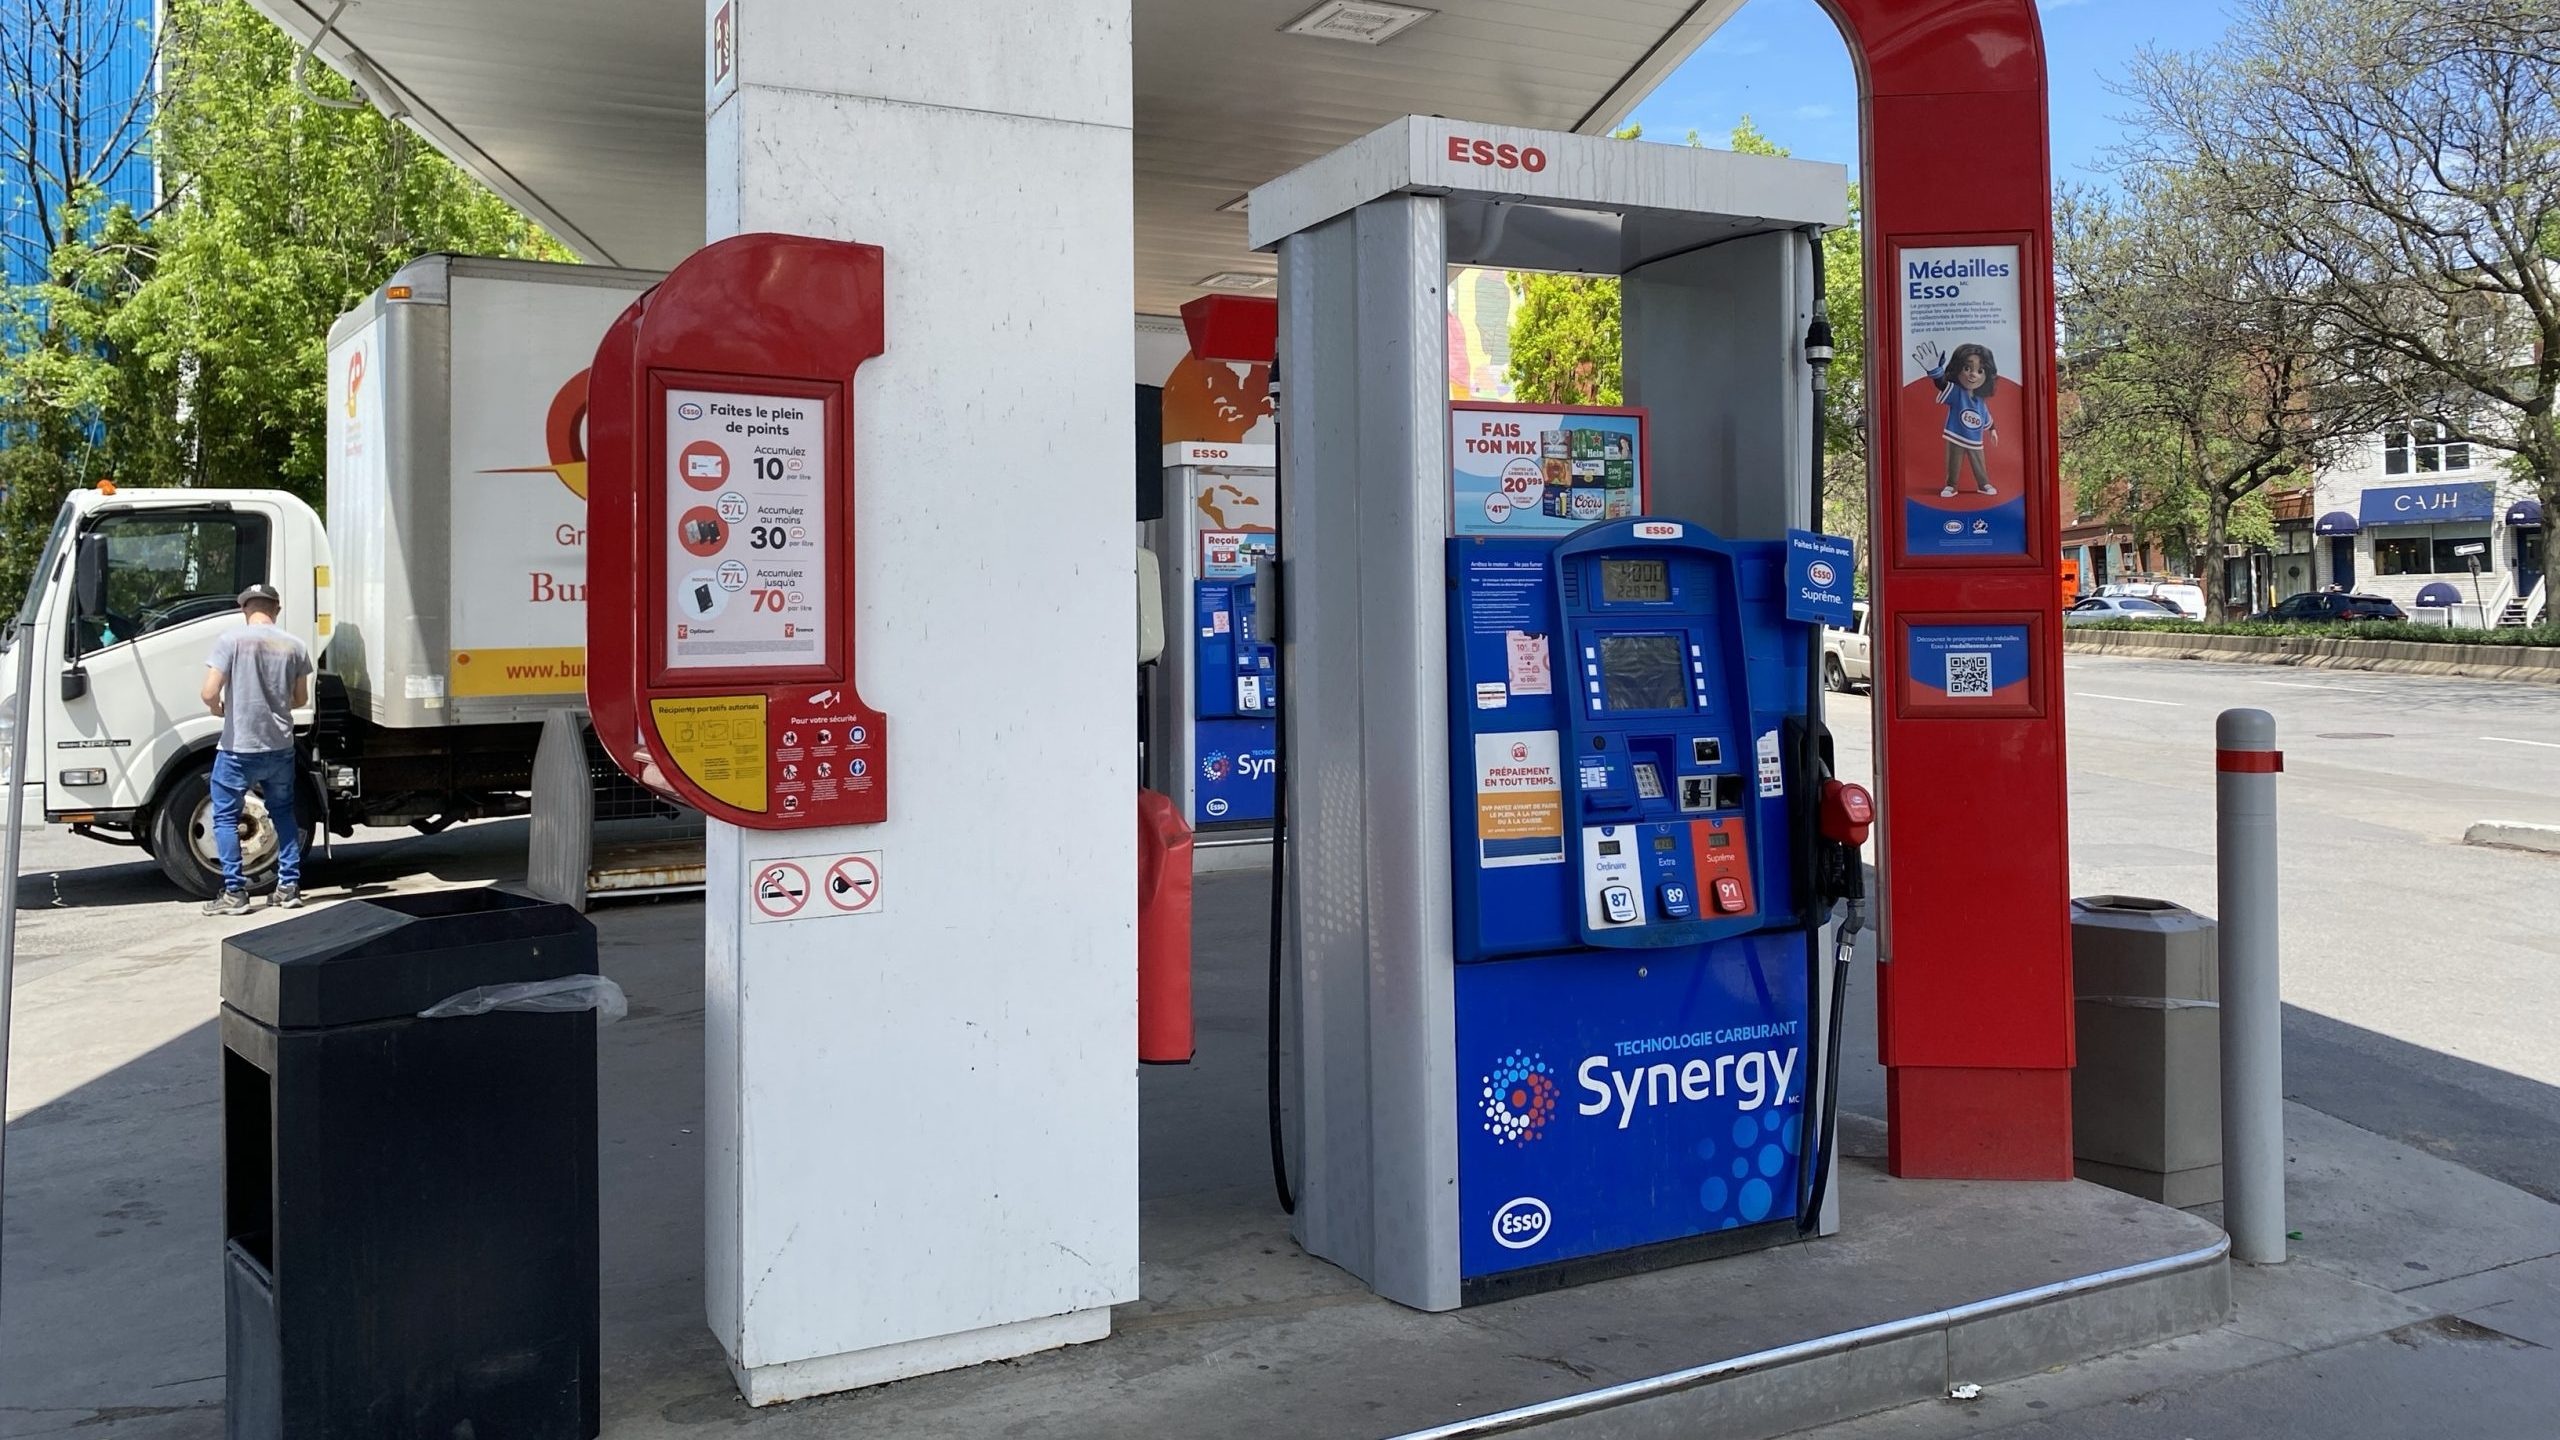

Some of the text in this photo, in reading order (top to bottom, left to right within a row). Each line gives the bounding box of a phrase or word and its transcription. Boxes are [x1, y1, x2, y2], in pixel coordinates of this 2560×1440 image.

[1448, 136, 1546, 173] ESSO
[1909, 258, 2009, 280] Médailles
[1909, 281, 1960, 300] Esso
[682, 403, 804, 422] Esso Faites le plein
[1963, 412, 1980, 425] Esso
[726, 421, 790, 437] de points
[1481, 422, 1521, 437] FAIS
[754, 446, 806, 456] Accumulez
[1192, 449, 1228, 458] ESSO
[1465, 439, 1502, 454] TON
[1506, 440, 1537, 455] MIX
[753, 457, 784, 480] 10
[1574, 494, 1602, 508] Coors
[2394, 492, 2458, 511] CAJH
[757, 506, 804, 515] Accumulez
[774, 516, 801, 525] moins
[750, 526, 787, 550] 30
[1645, 526, 1674, 535] ESSO
[1208, 536, 1239, 546] Reçois
[1793, 539, 1849, 557] Faites le plein avec
[756, 569, 804, 578] Accumulez
[1812, 567, 1831, 580] Esso
[750, 590, 785, 612] 70
[1801, 587, 1841, 604] Suprême
[658, 703, 759, 715] Récipients portatifs autorisés
[791, 713, 857, 725] Pour votre sécurité
[1238, 754, 1275, 780] Syn
[1489, 766, 1550, 777] PRÉPAIEMENT
[1484, 776, 1557, 787] EN TOUT TEMPS.
[1658, 857, 1676, 867] Extra
[1706, 853, 1735, 863] Suprême
[1596, 861, 1627, 871] Ordinaire
[1666, 888, 1684, 903] 89
[1721, 883, 1738, 898] 91
[1611, 892, 1627, 907] 87
[1615, 1020, 1797, 1057] TECHNOLOGIE CARBURANT
[1577, 1047, 1798, 1130] Synergy
[1502, 1212, 1543, 1235] Esso
